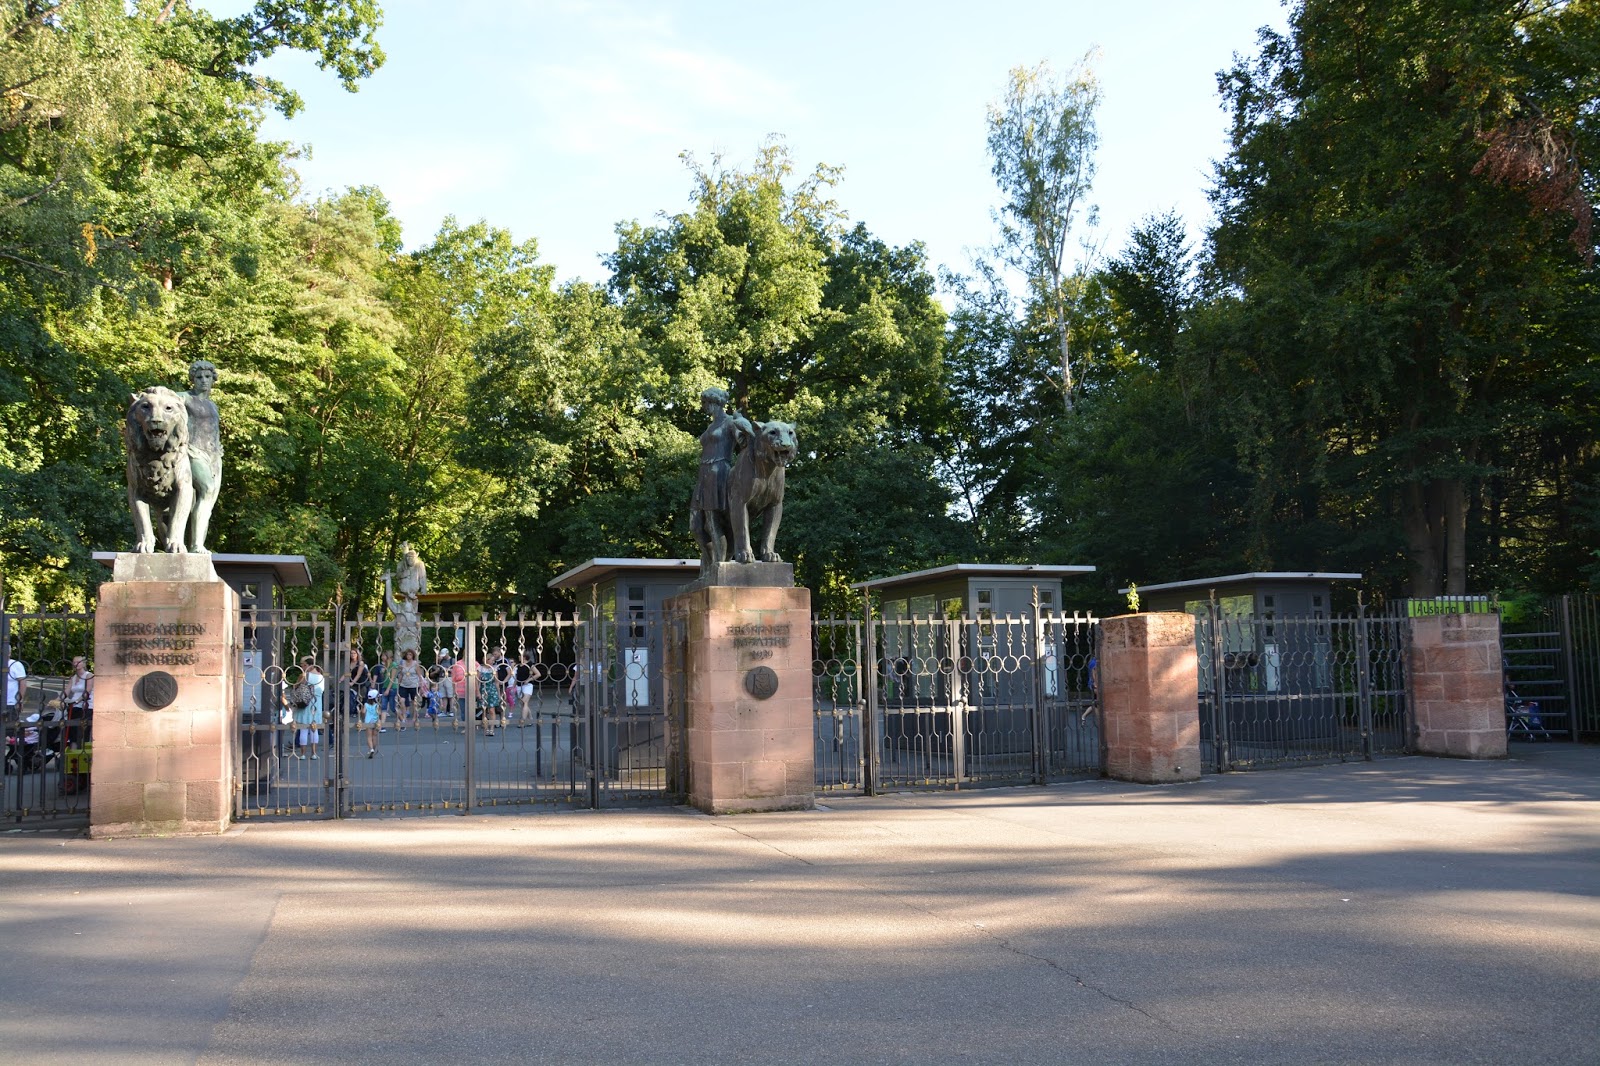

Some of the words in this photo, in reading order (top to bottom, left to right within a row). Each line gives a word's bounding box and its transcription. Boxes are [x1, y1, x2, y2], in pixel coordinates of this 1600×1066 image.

[111, 622, 206, 635] TIERGARTEN
[117, 638, 147, 650] DER
[148, 638, 198, 650] STADT
[114, 651, 199, 665] NÜRNBERG
